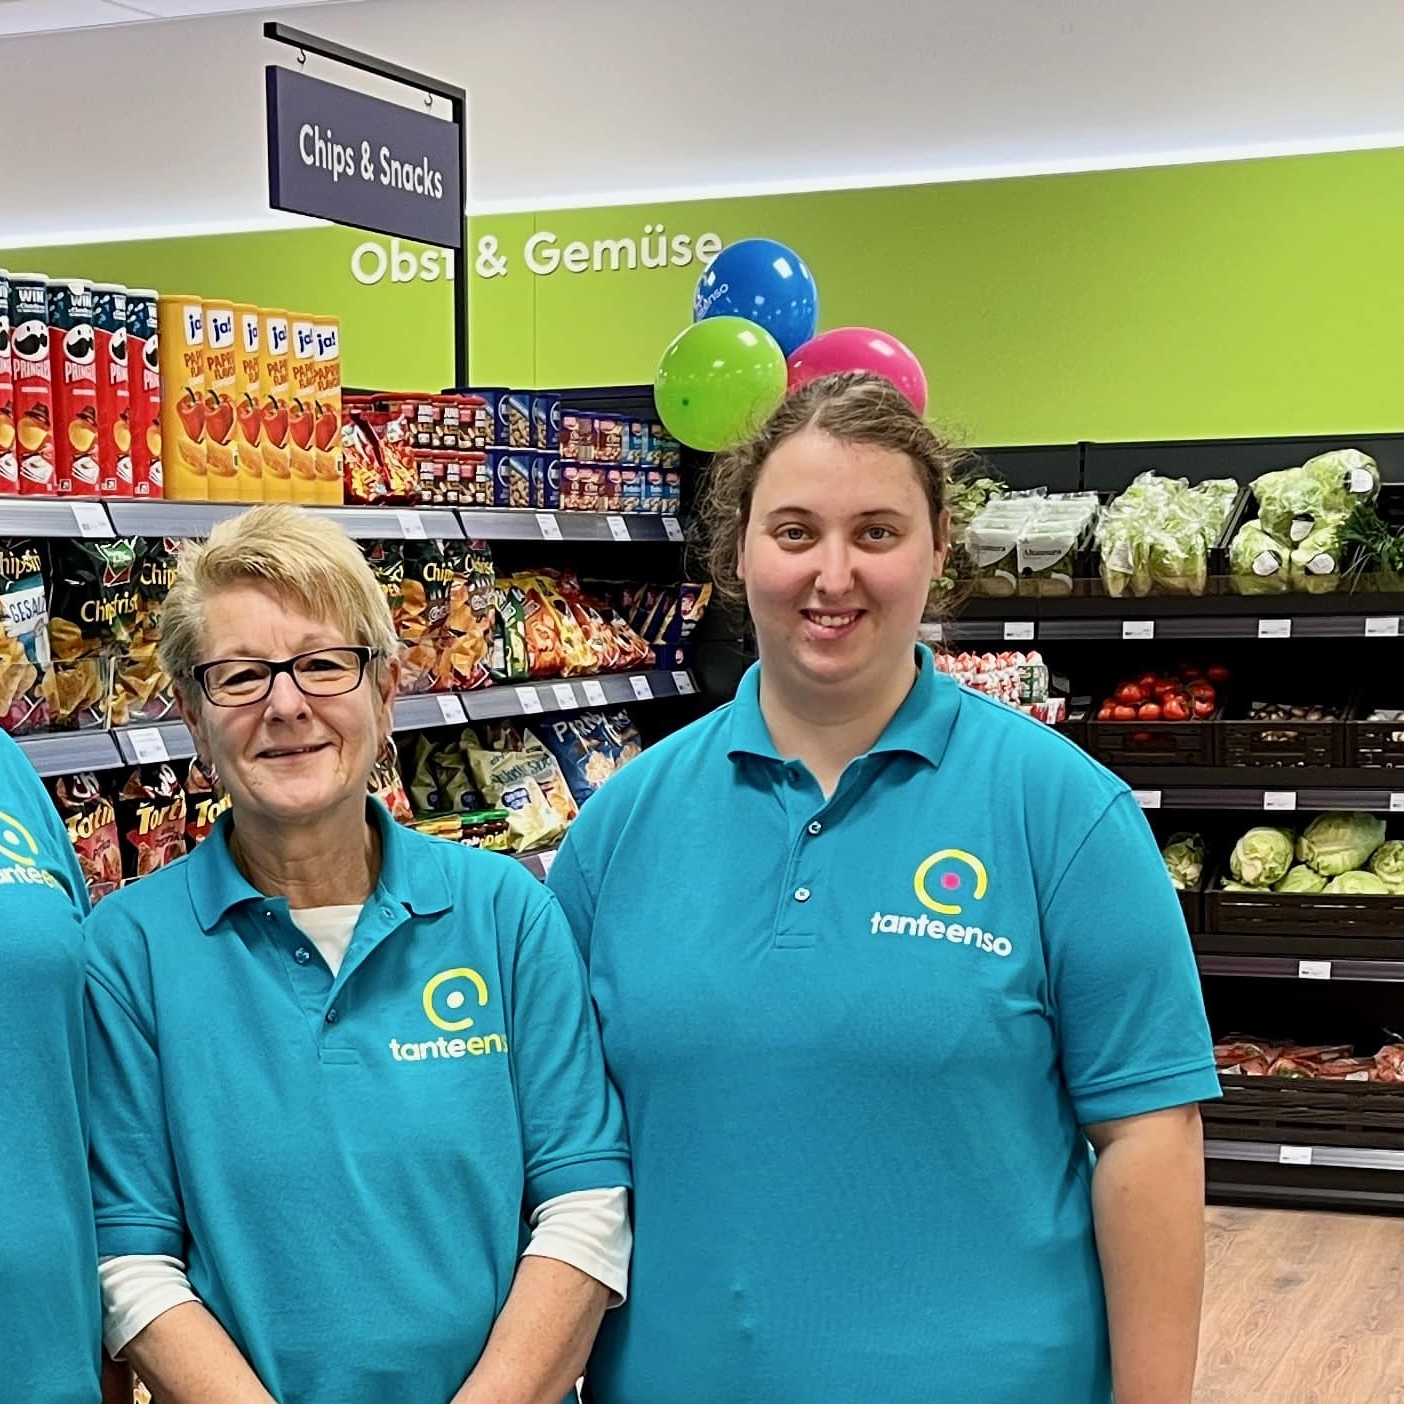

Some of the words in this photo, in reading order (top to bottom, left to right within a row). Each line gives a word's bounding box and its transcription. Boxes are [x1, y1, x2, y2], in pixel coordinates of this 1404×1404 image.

[299, 123, 355, 182] Chips
[361, 140, 374, 182] &
[380, 146, 444, 199] Snacks
[476, 234, 507, 278] &
[524, 224, 723, 275] Gemüse
[213, 316, 233, 342] ja!
[317, 332, 336, 357] ja!
[870, 911, 1013, 957] tanteenso
